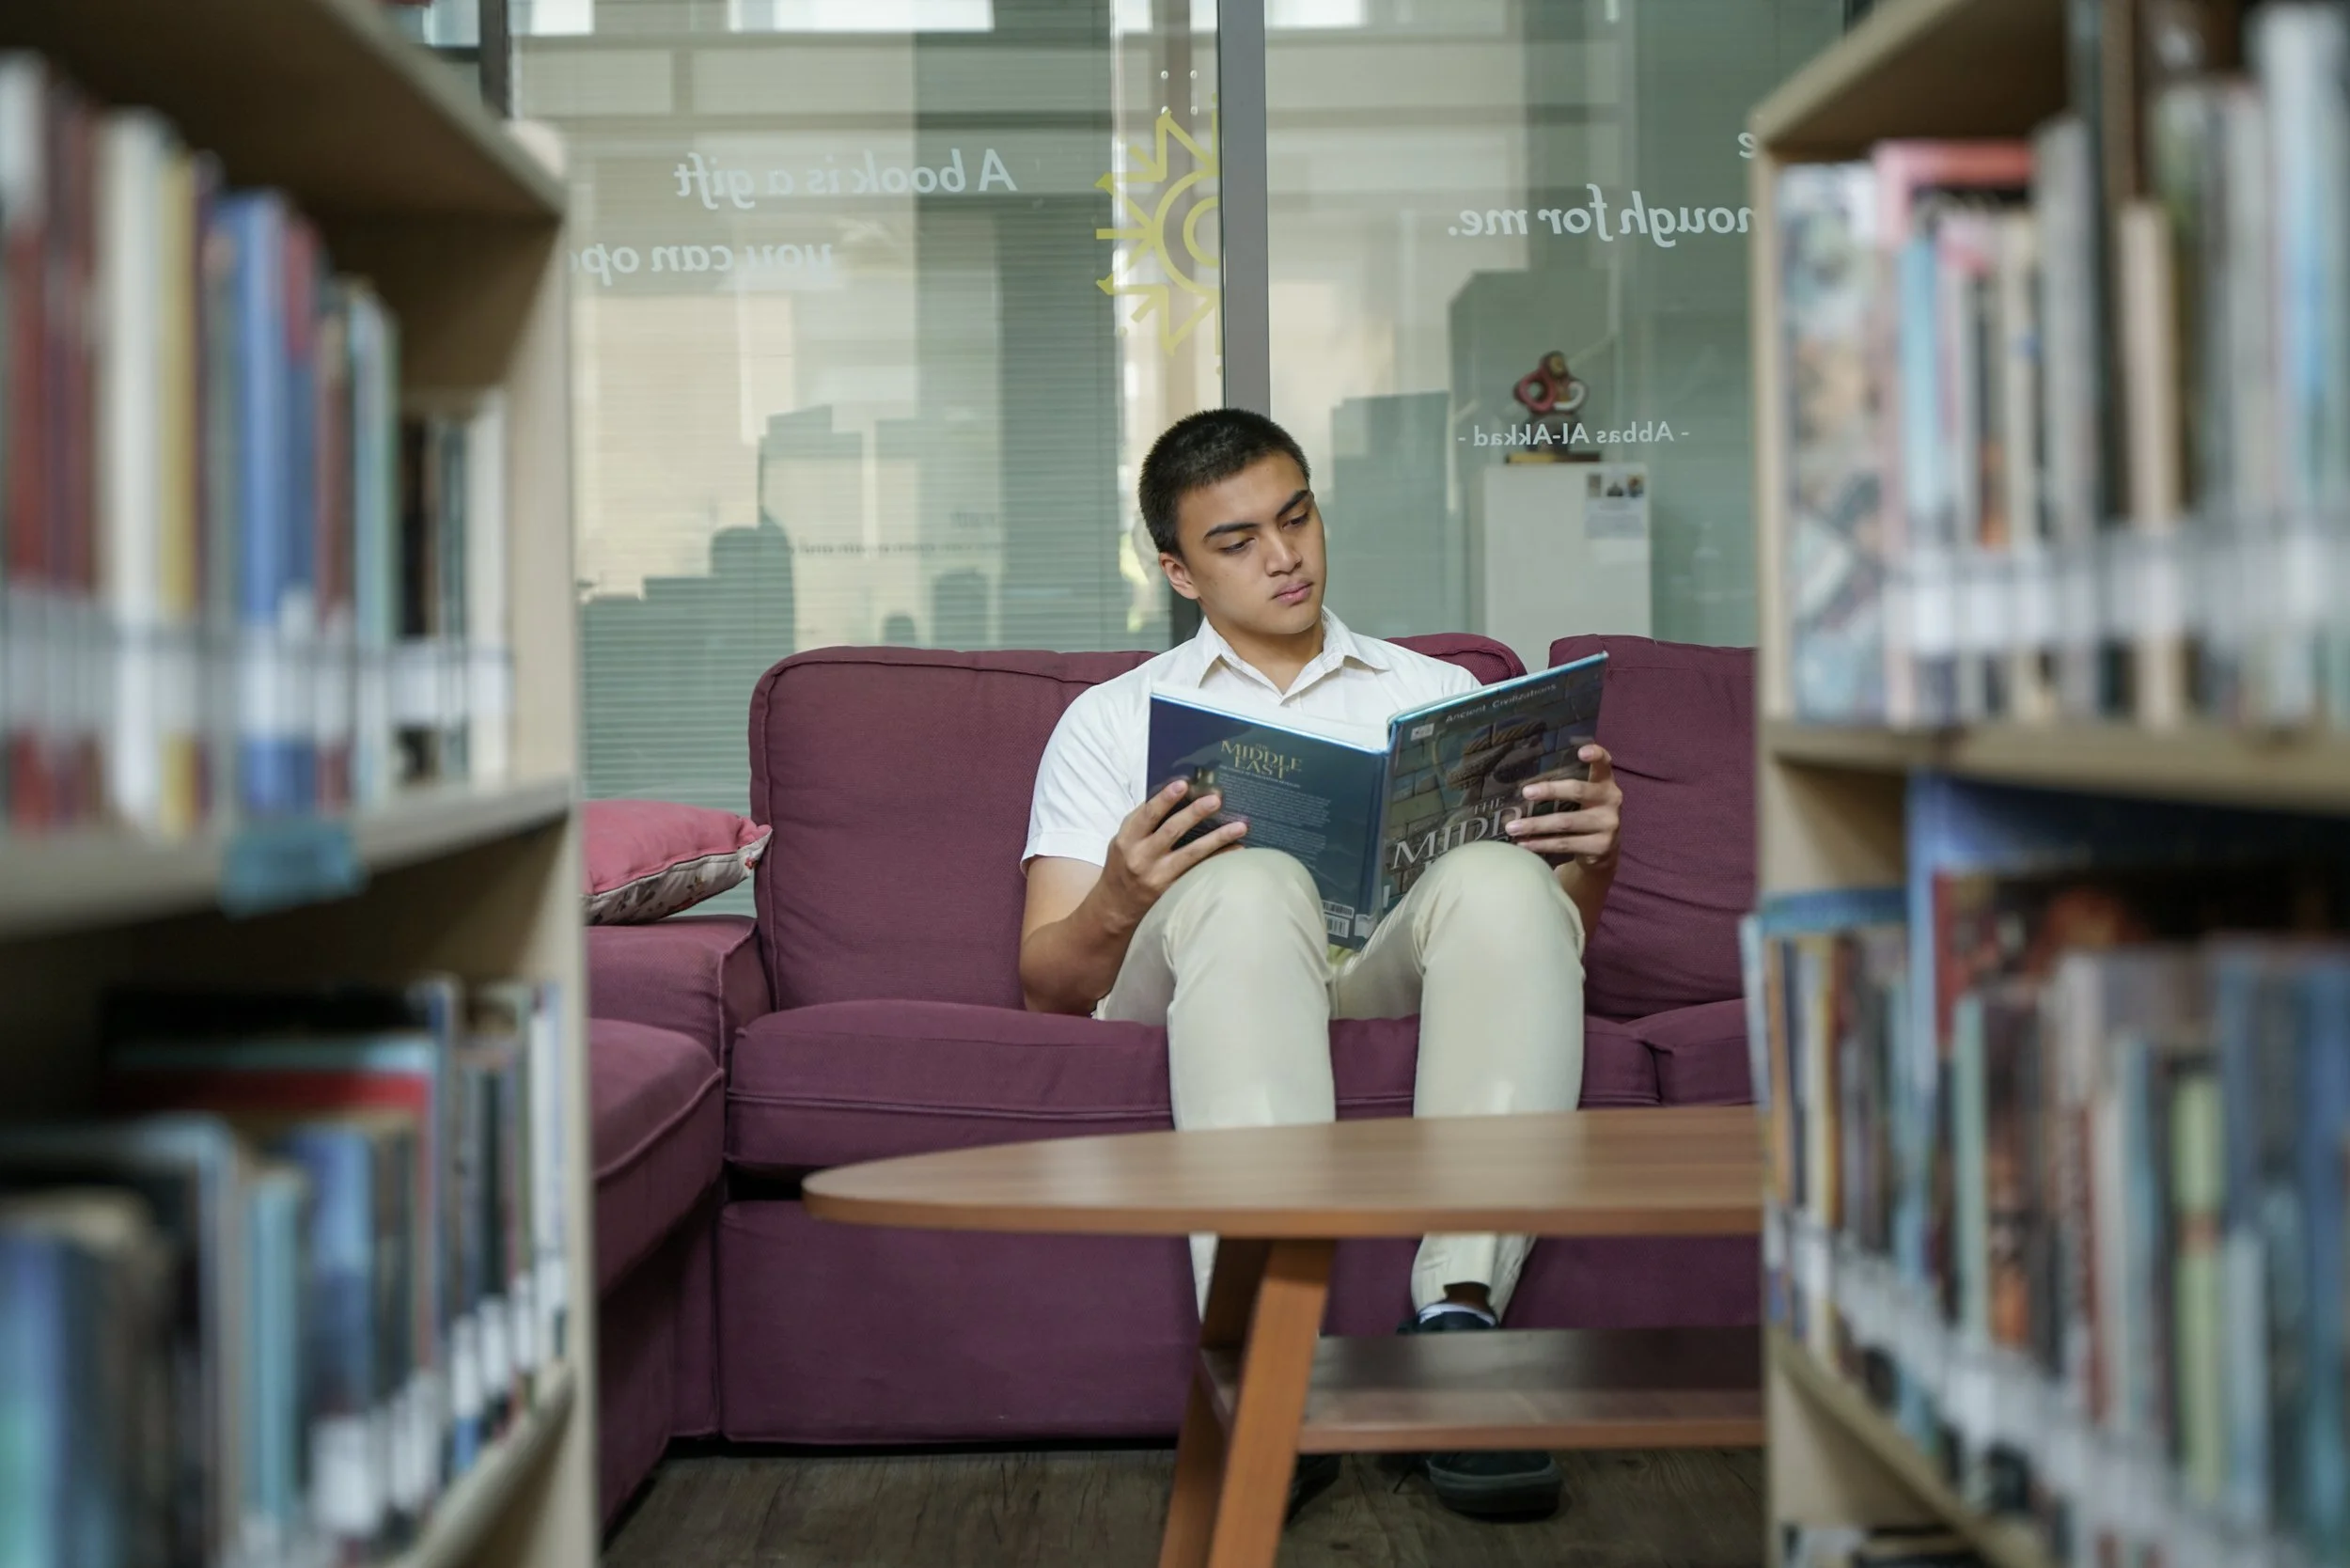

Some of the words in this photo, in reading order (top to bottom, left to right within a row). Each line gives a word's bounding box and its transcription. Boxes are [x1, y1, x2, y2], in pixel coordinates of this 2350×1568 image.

[1445, 703, 1486, 724] Ancient
[1492, 683, 1558, 709] Civilizations
[1220, 740, 1303, 772] MIDDLE
[1234, 756, 1284, 779] EAST
[1473, 796, 1506, 815] THE
[1389, 798, 1560, 870] MIDD
